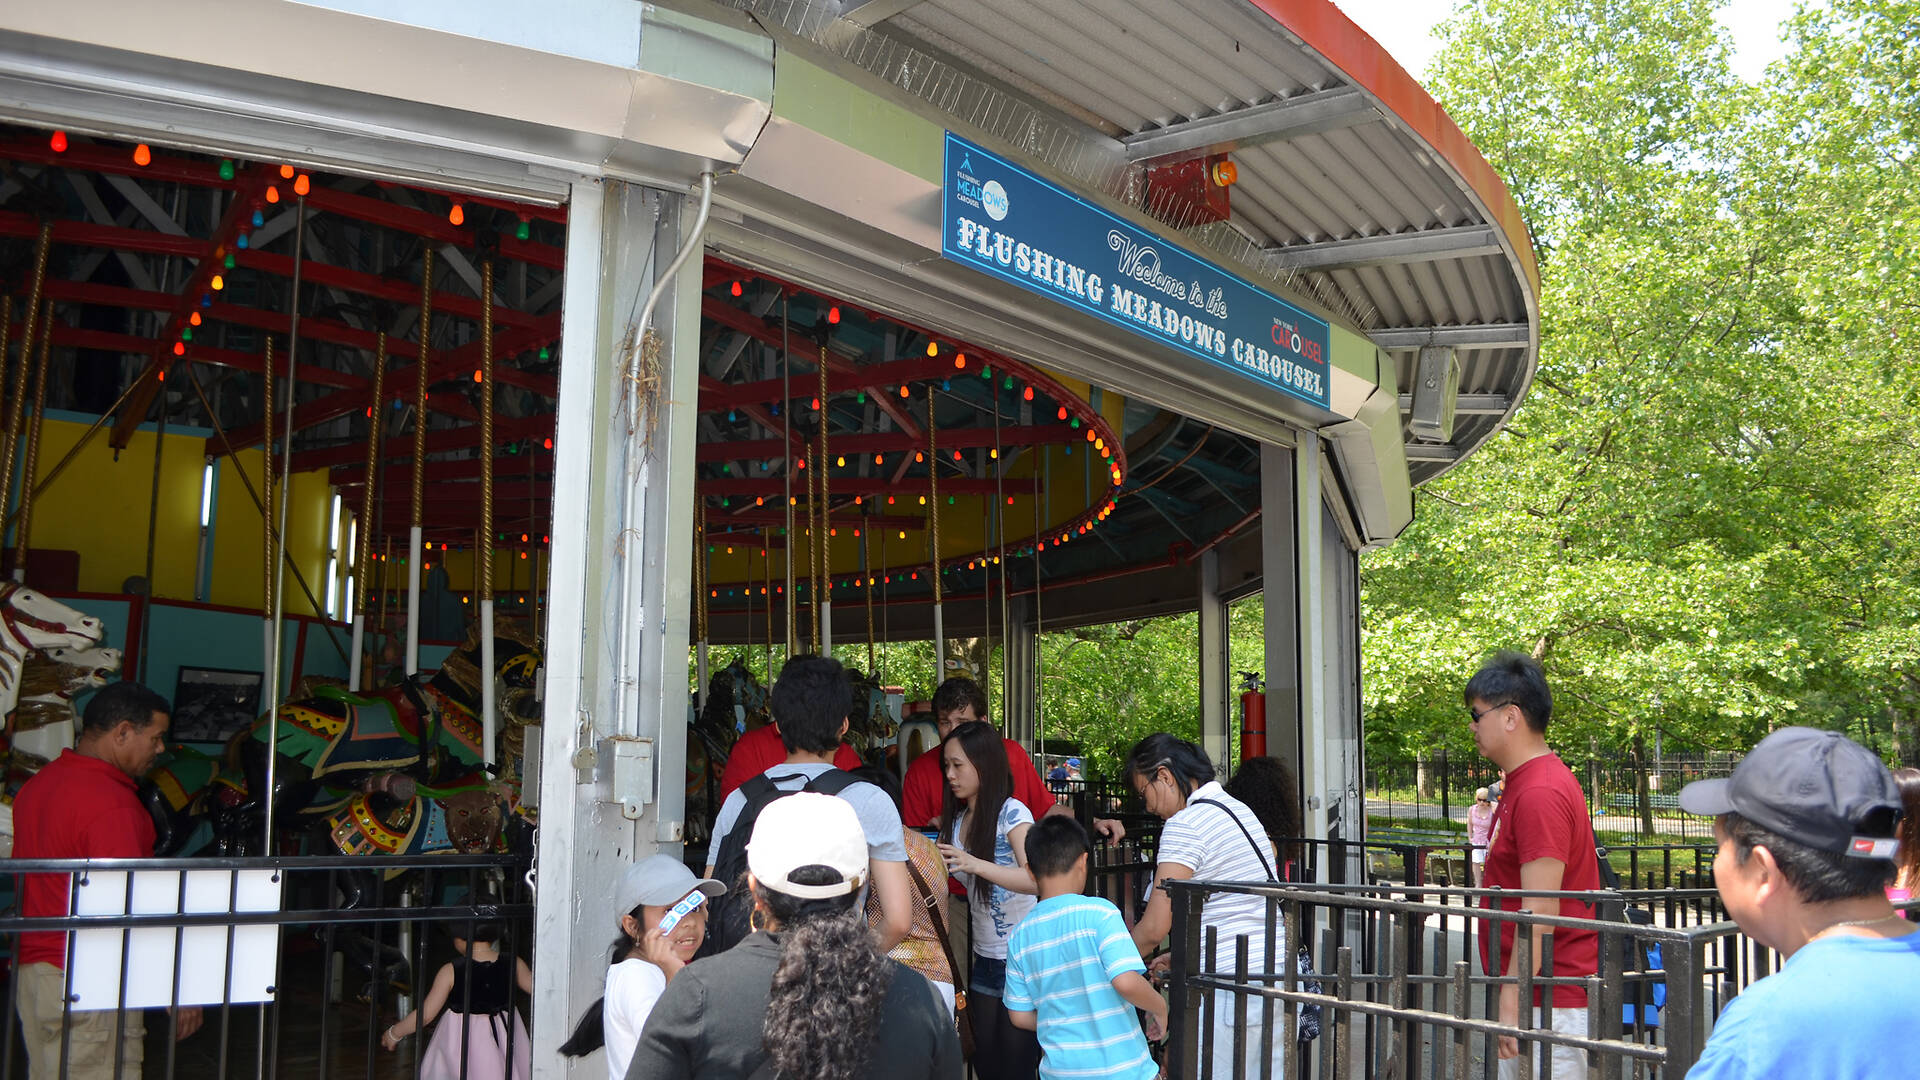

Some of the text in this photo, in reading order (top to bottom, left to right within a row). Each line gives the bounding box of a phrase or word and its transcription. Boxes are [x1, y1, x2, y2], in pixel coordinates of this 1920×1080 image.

[957, 178, 1007, 212] MEADOWS
[957, 217, 1323, 399] FLUSHING MEADOWS CAROUSEL
[1188, 281, 1205, 308] to
[1206, 287, 1228, 319] the
[1271, 325, 1324, 365] CAROUSEL
